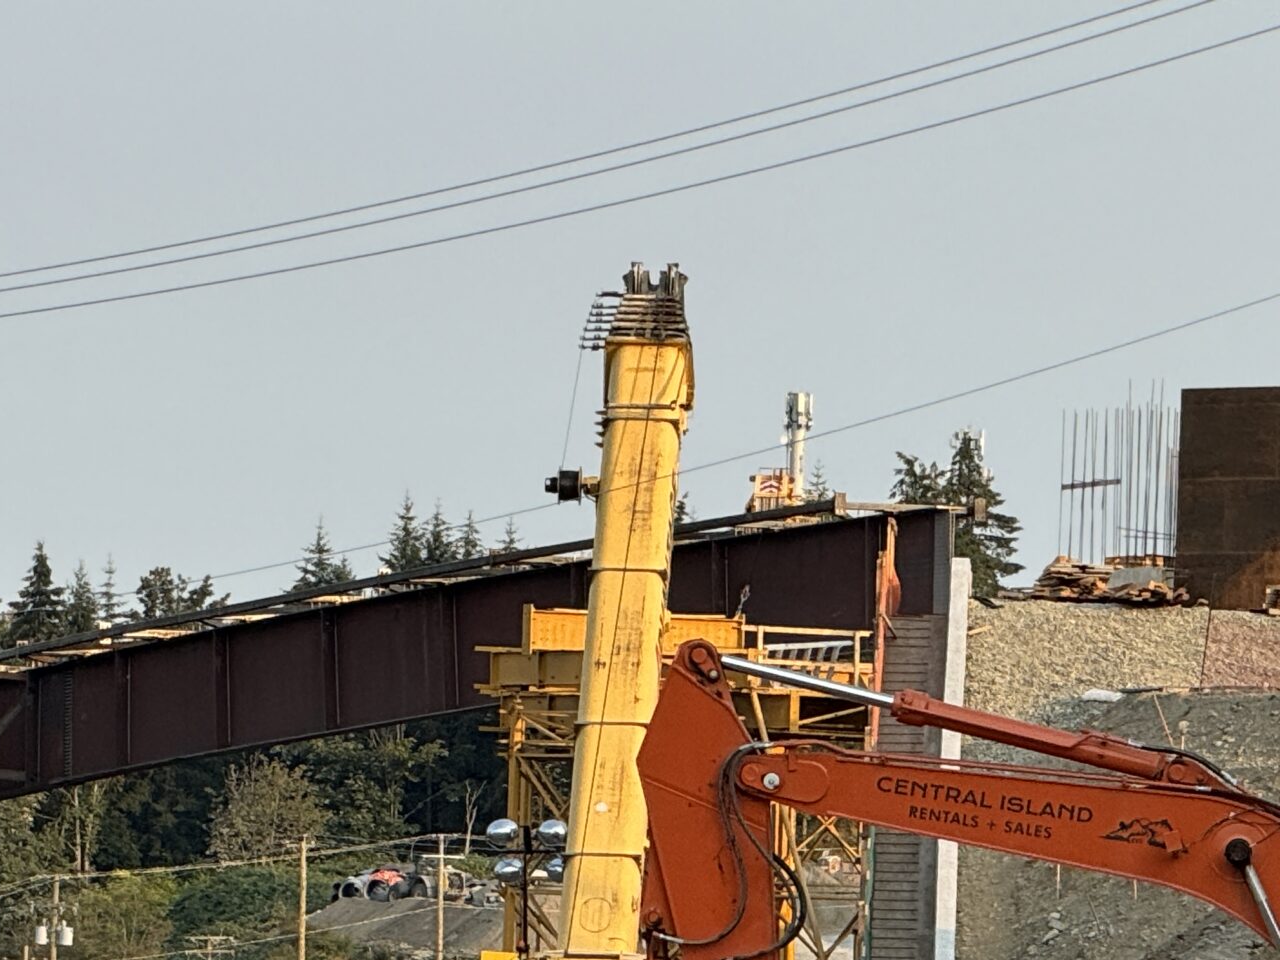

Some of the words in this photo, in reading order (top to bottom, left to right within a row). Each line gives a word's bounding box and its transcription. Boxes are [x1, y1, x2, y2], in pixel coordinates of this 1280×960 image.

[877, 776, 992, 809] CENTRAL
[1000, 795, 1094, 823] ISLAND
[909, 805, 979, 828] RENTALS
[1004, 820, 1052, 839] SALES
